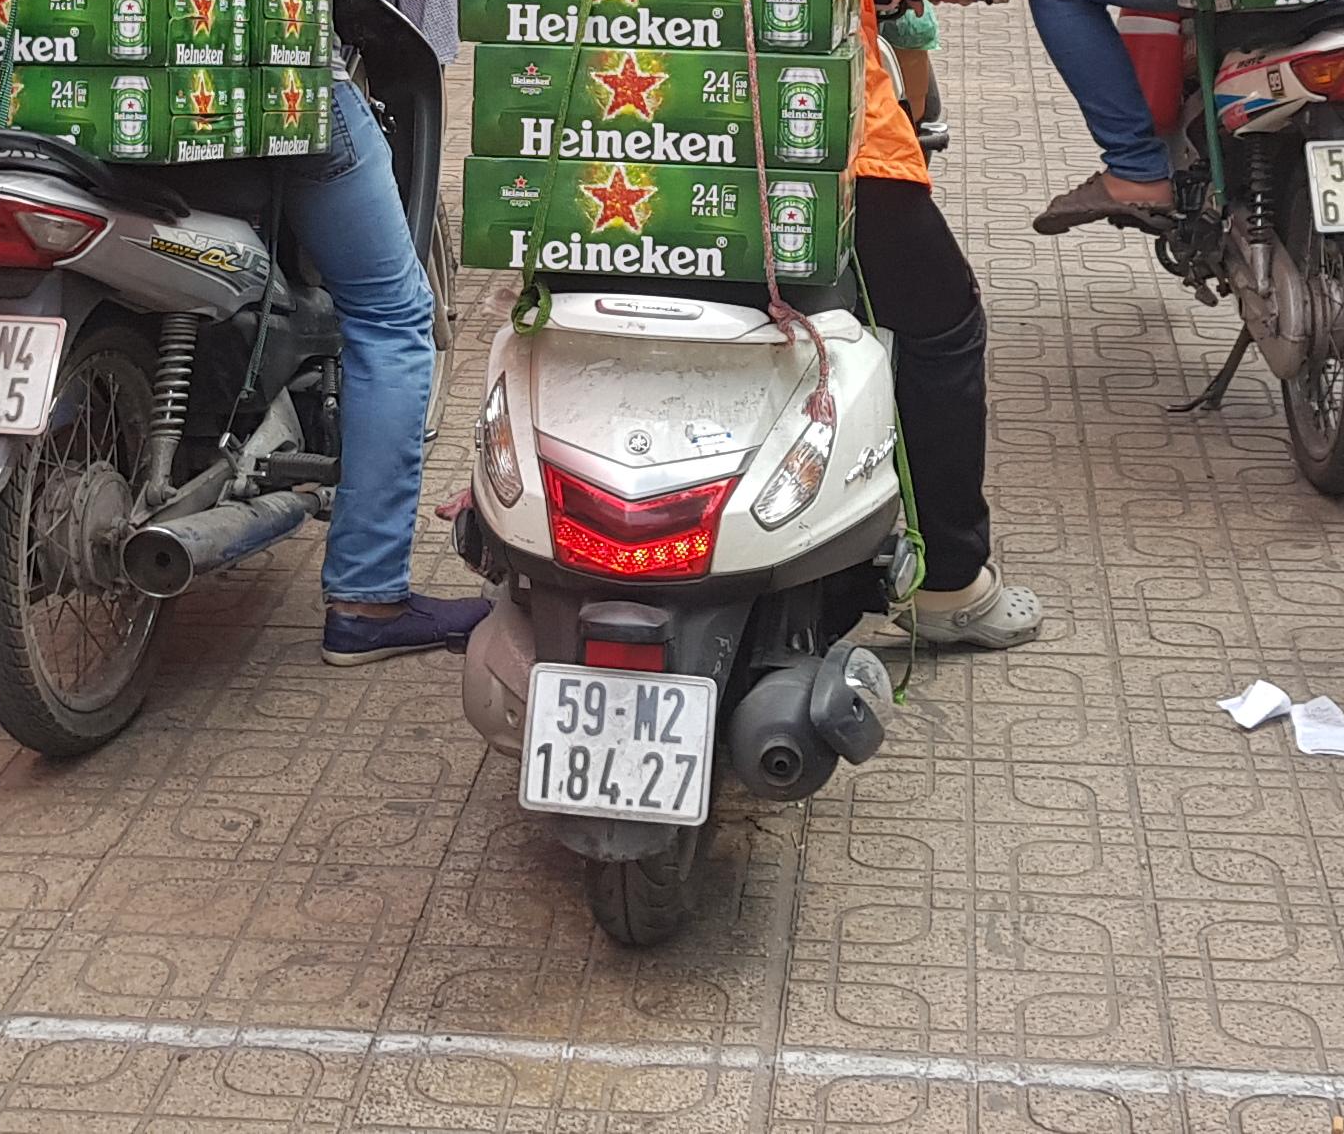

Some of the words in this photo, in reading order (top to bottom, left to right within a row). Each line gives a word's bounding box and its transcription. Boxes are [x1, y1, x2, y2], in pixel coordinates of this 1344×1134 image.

[506, 3, 722, 48] Heineken
[175, 43, 224, 66] Heineken
[270, 44, 312, 66] Heineken
[51, 79, 73, 99] 24
[702, 71, 731, 92] 24
[702, 92, 730, 103] PACK
[178, 139, 226, 163] Heineken
[268, 133, 311, 156] Heineken
[519, 117, 737, 164] Heineken
[691, 184, 719, 206] 24
[691, 206, 718, 217] PACK
[151, 238, 200, 260] WAVE
[509, 229, 725, 278] Heineken
